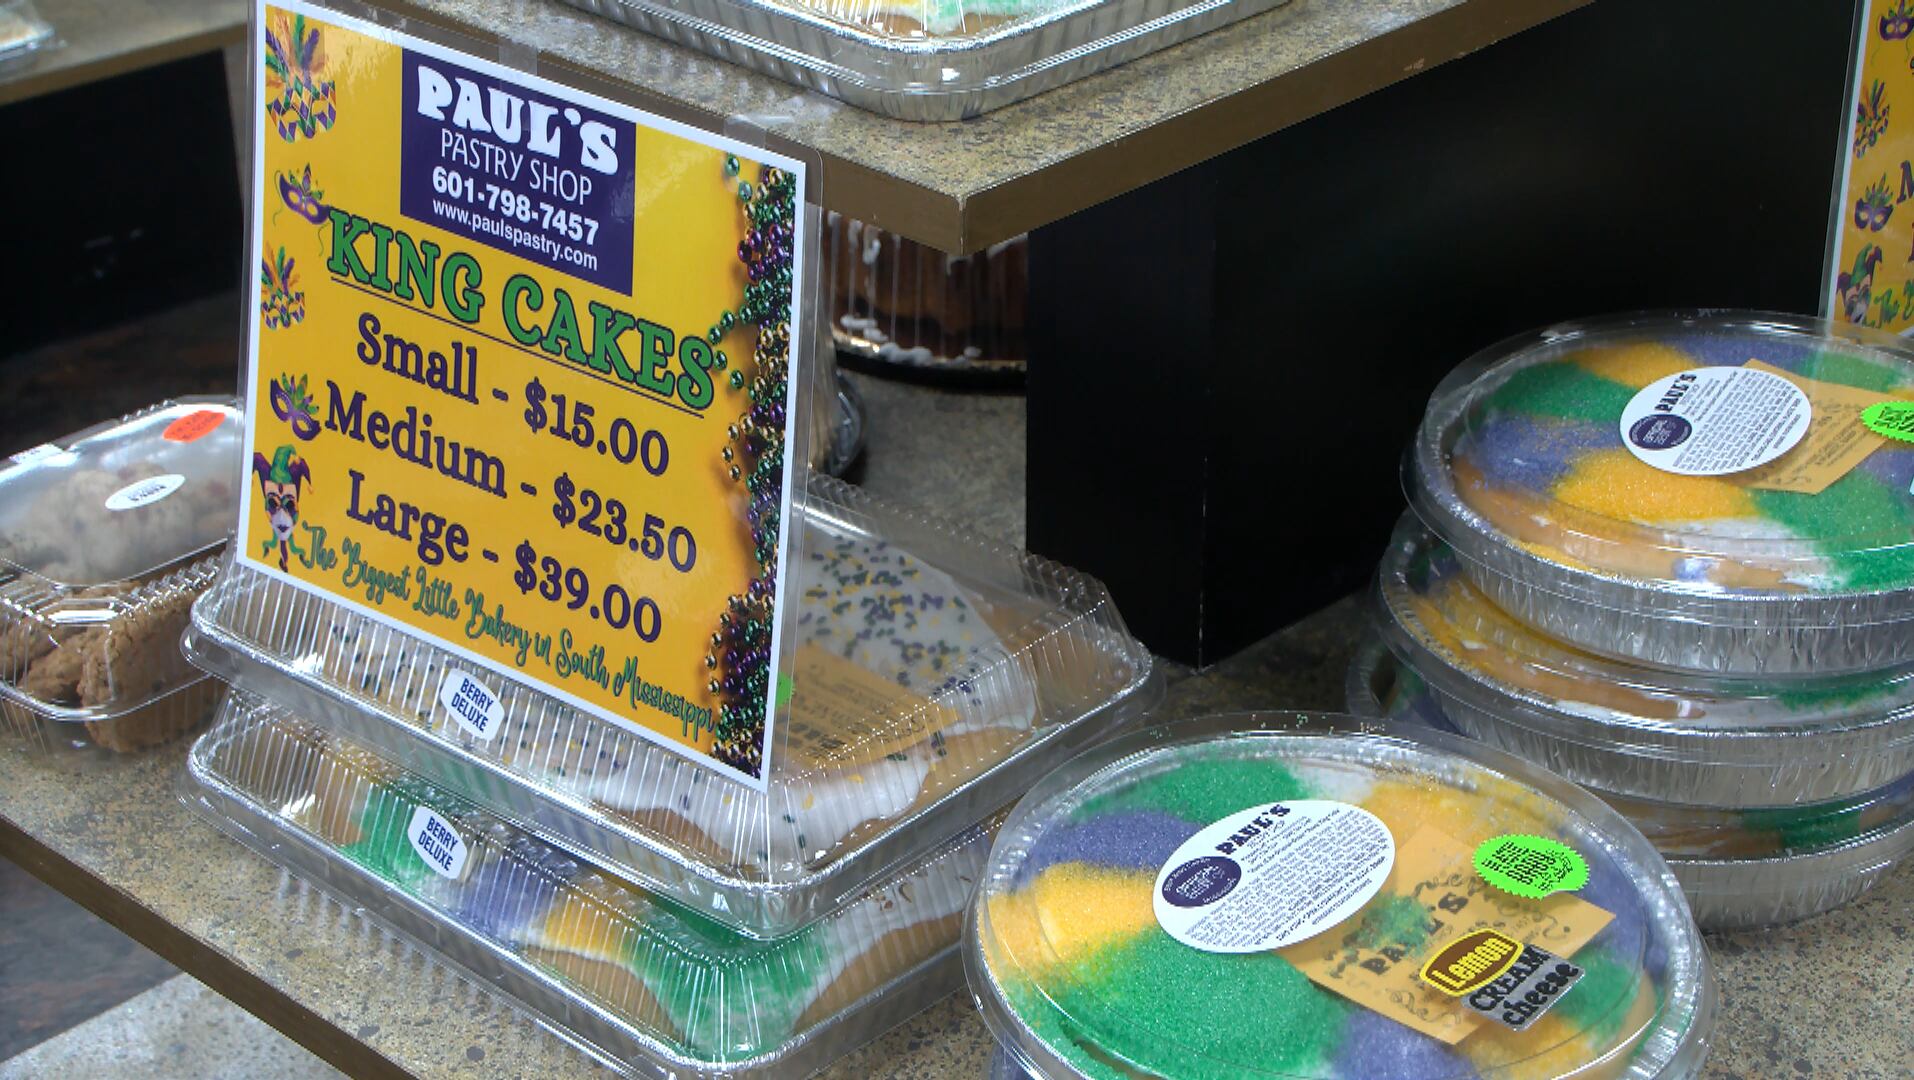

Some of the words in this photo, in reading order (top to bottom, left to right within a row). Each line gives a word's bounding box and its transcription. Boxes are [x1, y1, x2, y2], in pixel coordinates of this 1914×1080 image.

[416, 64, 619, 175] PAUL'S
[441, 129, 522, 181] PASTRY
[529, 158, 593, 206] SHOP
[432, 166, 600, 246] 601-798-7457
[433, 198, 598, 271] www.paulspastry.com
[327, 210, 485, 325] KING
[502, 274, 714, 410] CAKES
[357, 312, 477, 404] Small
[524, 376, 670, 476] $15.00
[1654, 373, 1698, 413] PAUL'S
[325, 382, 507, 499] Medium
[552, 473, 697, 573] $23.50
[346, 470, 469, 566] Large
[514, 540, 662, 643] $39.00
[302, 522, 337, 570] The
[342, 538, 410, 604] Biggest
[412, 566, 460, 617] Little
[465, 586, 532, 668] Bakery
[533, 628, 552, 662] in
[556, 629, 610, 686] South
[614, 657, 716, 745] Mississippi
[451, 692, 488, 732] DELUXE
[460, 678, 494, 713] BERRY
[418, 830, 453, 871] DELUXE
[426, 816, 458, 851] BERRY
[1215, 804, 1291, 855] PAUL'S
[1360, 892, 1469, 975] PAL'S
[1431, 937, 1514, 989] Lemon
[1469, 945, 1550, 1012] CREAM
[1502, 962, 1579, 1026] cheese
